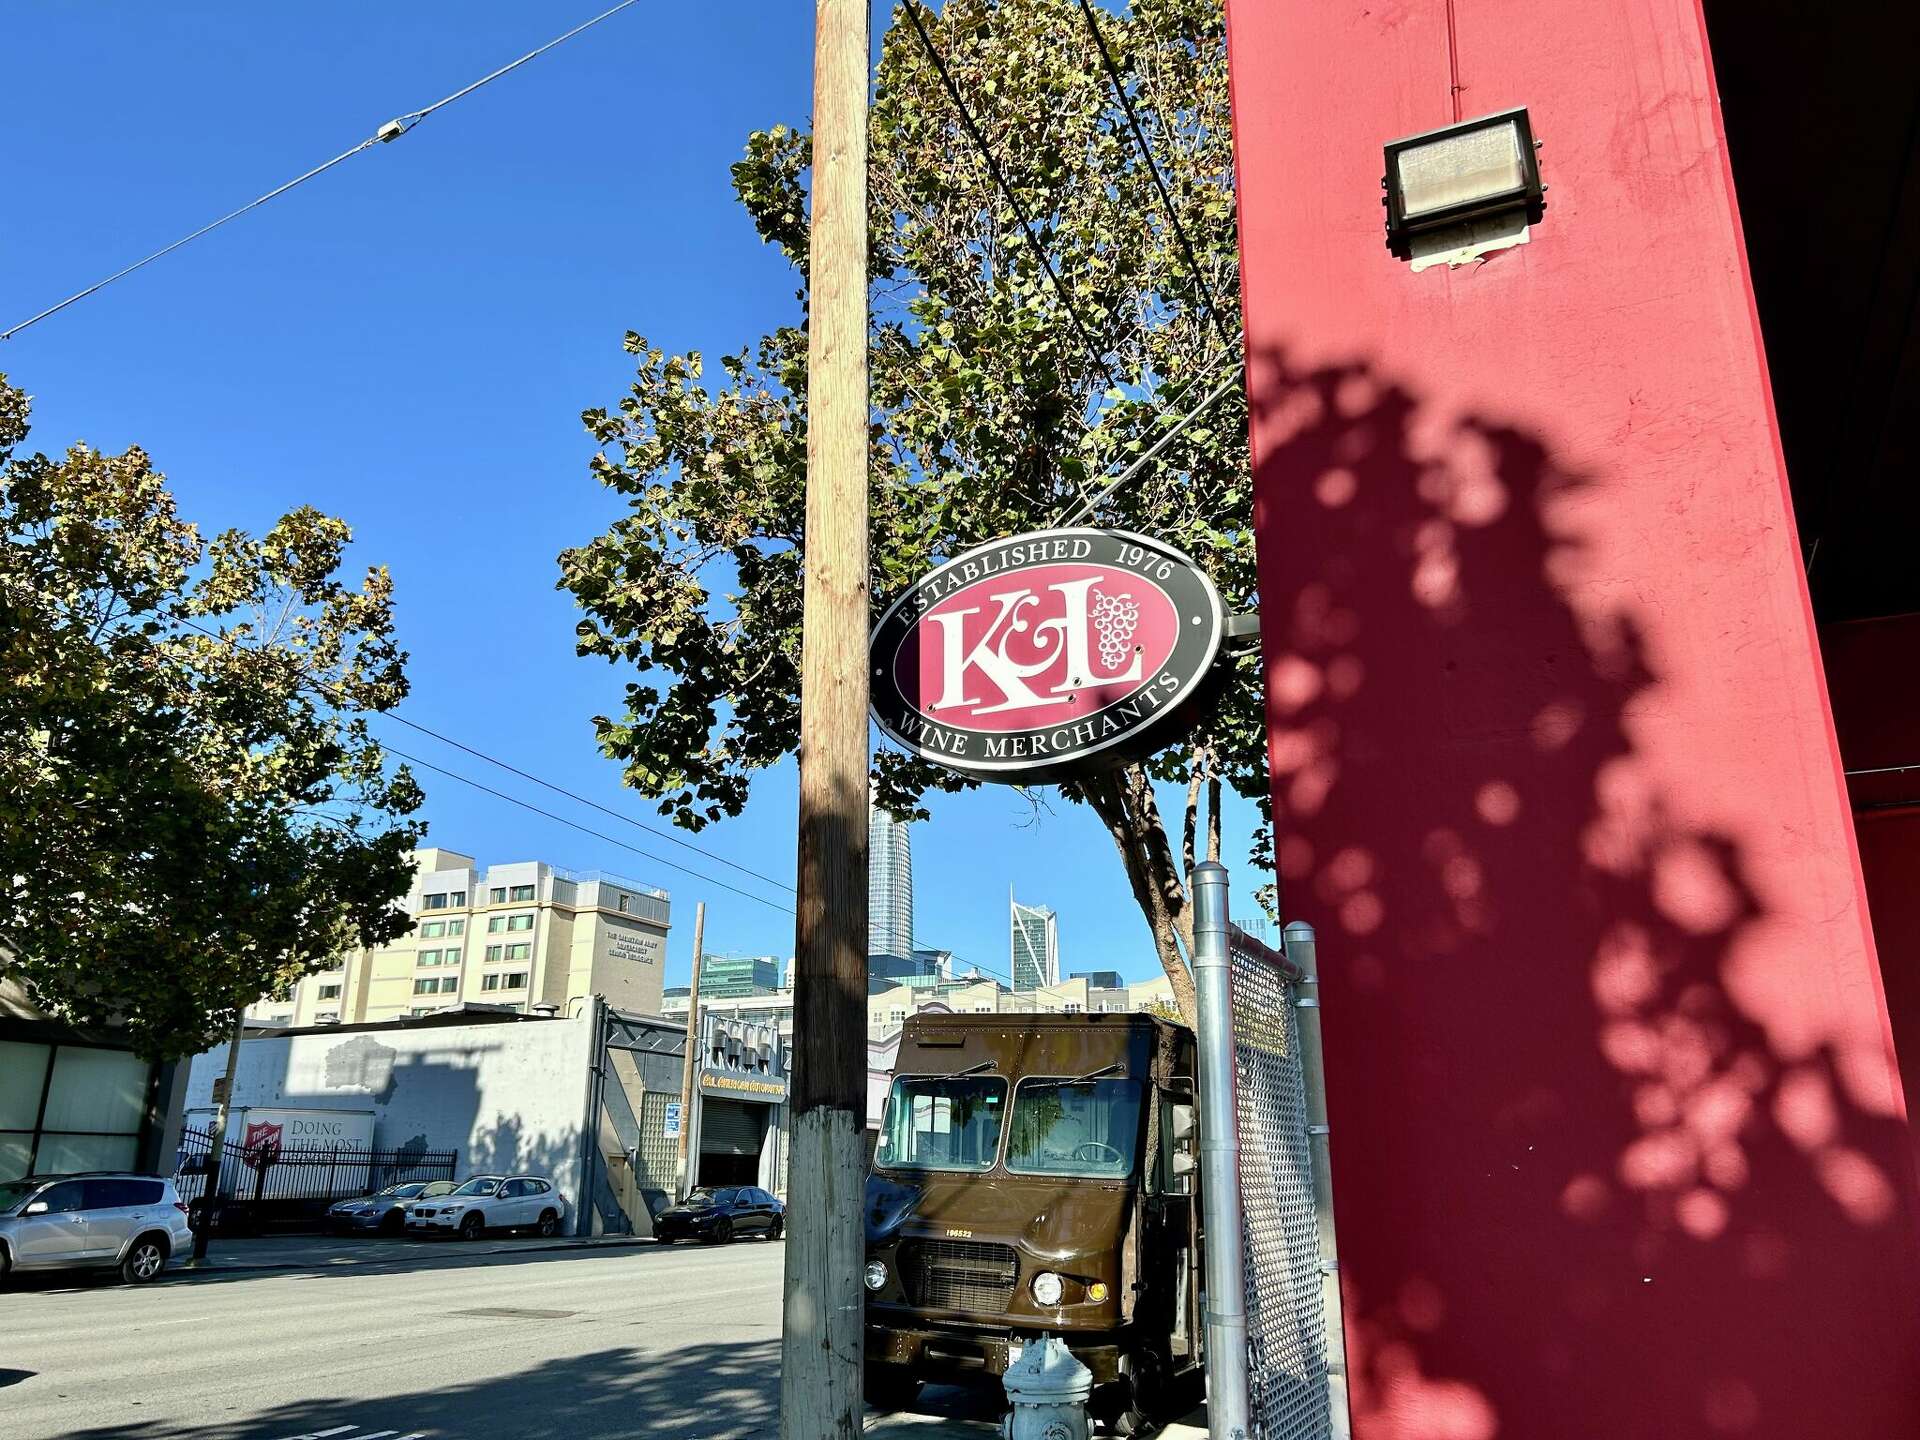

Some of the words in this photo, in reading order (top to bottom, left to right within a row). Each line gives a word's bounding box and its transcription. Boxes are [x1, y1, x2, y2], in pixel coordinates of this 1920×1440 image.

[896, 538, 1092, 627] ESTABLISHED
[1114, 542, 1176, 581] 1976
[927, 575, 1142, 716] K&L
[899, 711, 968, 755] WINE
[983, 671, 1180, 759] MERCHANTS
[253, 1126, 269, 1142] THE
[289, 1138, 319, 1151] THE
[323, 1138, 363, 1152] MOST
[291, 1120, 342, 1135] DOING
